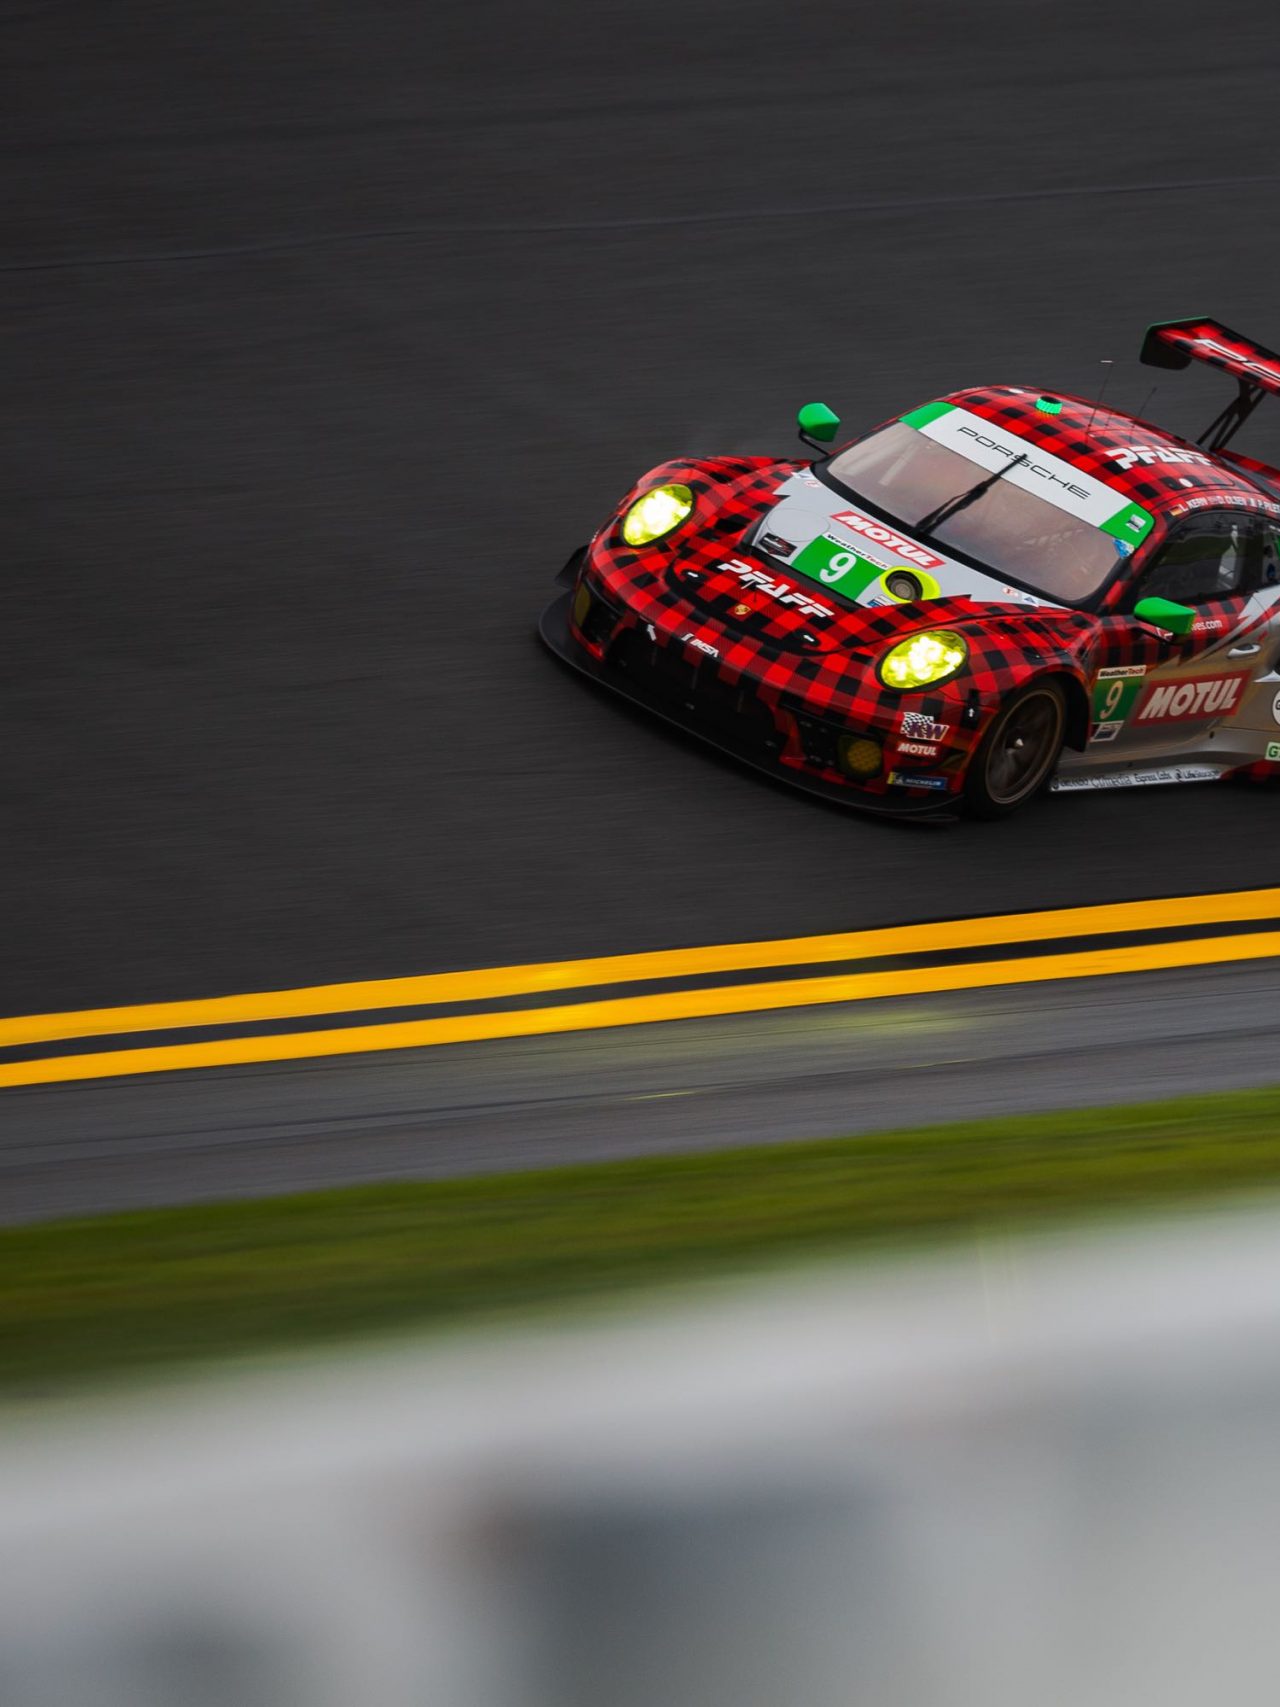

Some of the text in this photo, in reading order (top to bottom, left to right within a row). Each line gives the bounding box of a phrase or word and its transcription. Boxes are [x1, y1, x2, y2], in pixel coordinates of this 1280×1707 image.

[957, 426, 1091, 500] PORSCHE
[1104, 445, 1213, 470] PFAFF
[827, 534, 889, 569] WeatherTech
[838, 515, 937, 566] MOTUL
[819, 552, 857, 583] 9
[717, 559, 835, 618] PFAFF
[1099, 667, 1144, 678] WeatherTech
[1100, 680, 1124, 719] 9
[1138, 677, 1242, 720] MOTUL
[907, 721, 950, 741] KW
[897, 742, 937, 756] MOTUL
